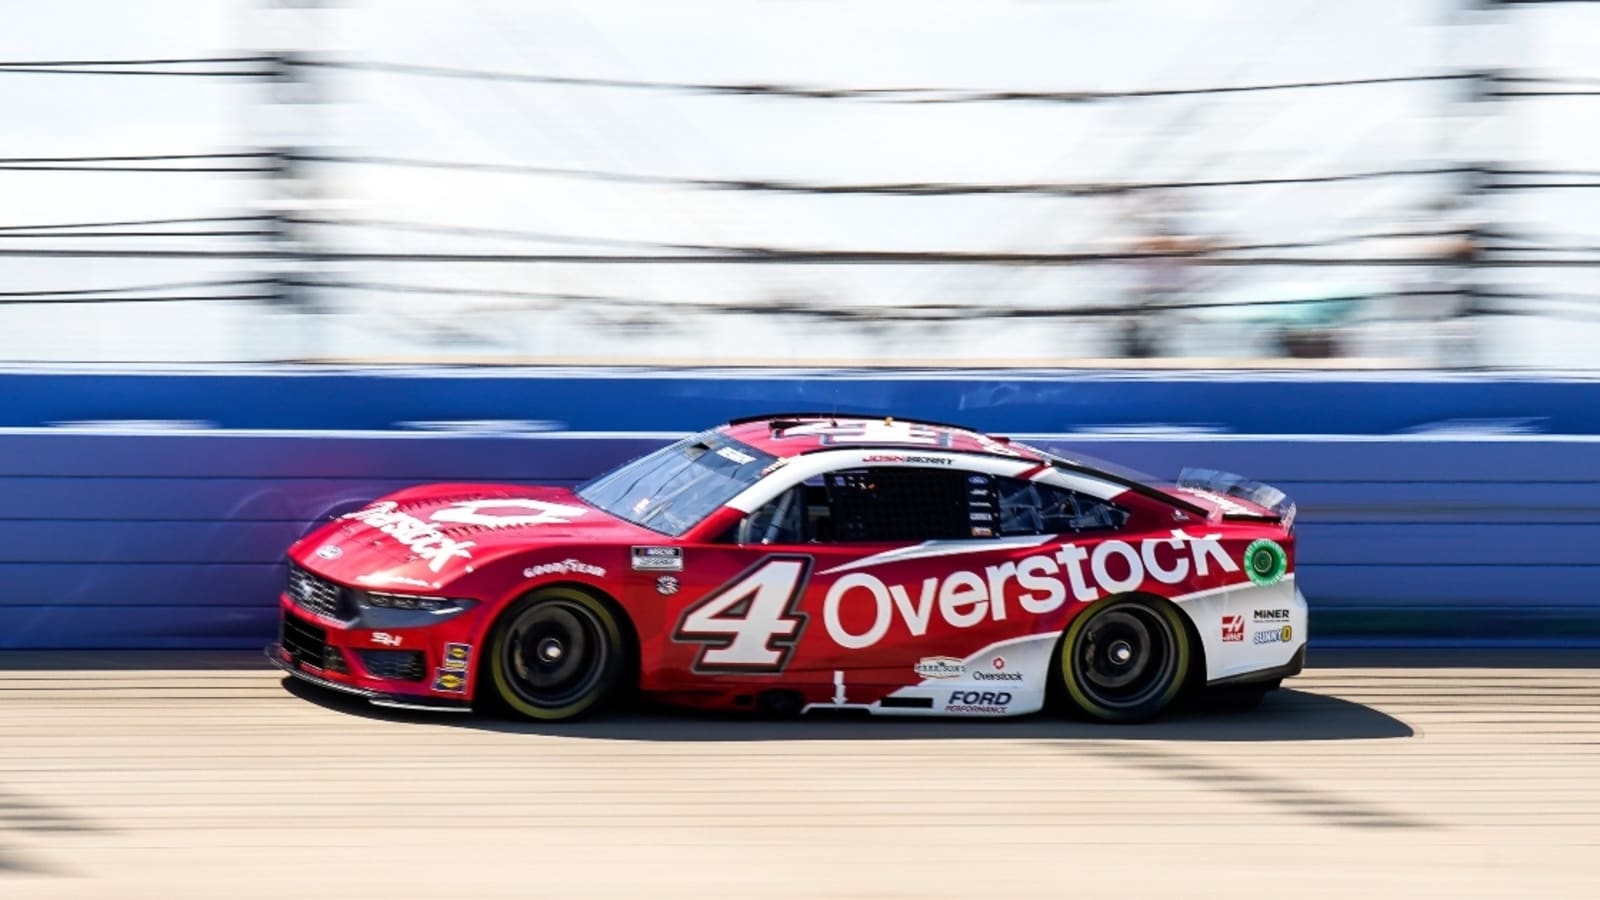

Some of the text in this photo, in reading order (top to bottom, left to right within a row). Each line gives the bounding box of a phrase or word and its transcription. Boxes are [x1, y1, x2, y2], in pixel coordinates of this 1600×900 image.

[823, 528, 1240, 650] Overstock
[671, 553, 814, 675] 4
[1253, 609, 1290, 619] MINER
[972, 670, 1024, 681] Overstock
[948, 690, 1013, 706] FORD
[944, 704, 1008, 714] PERFORMANCE
